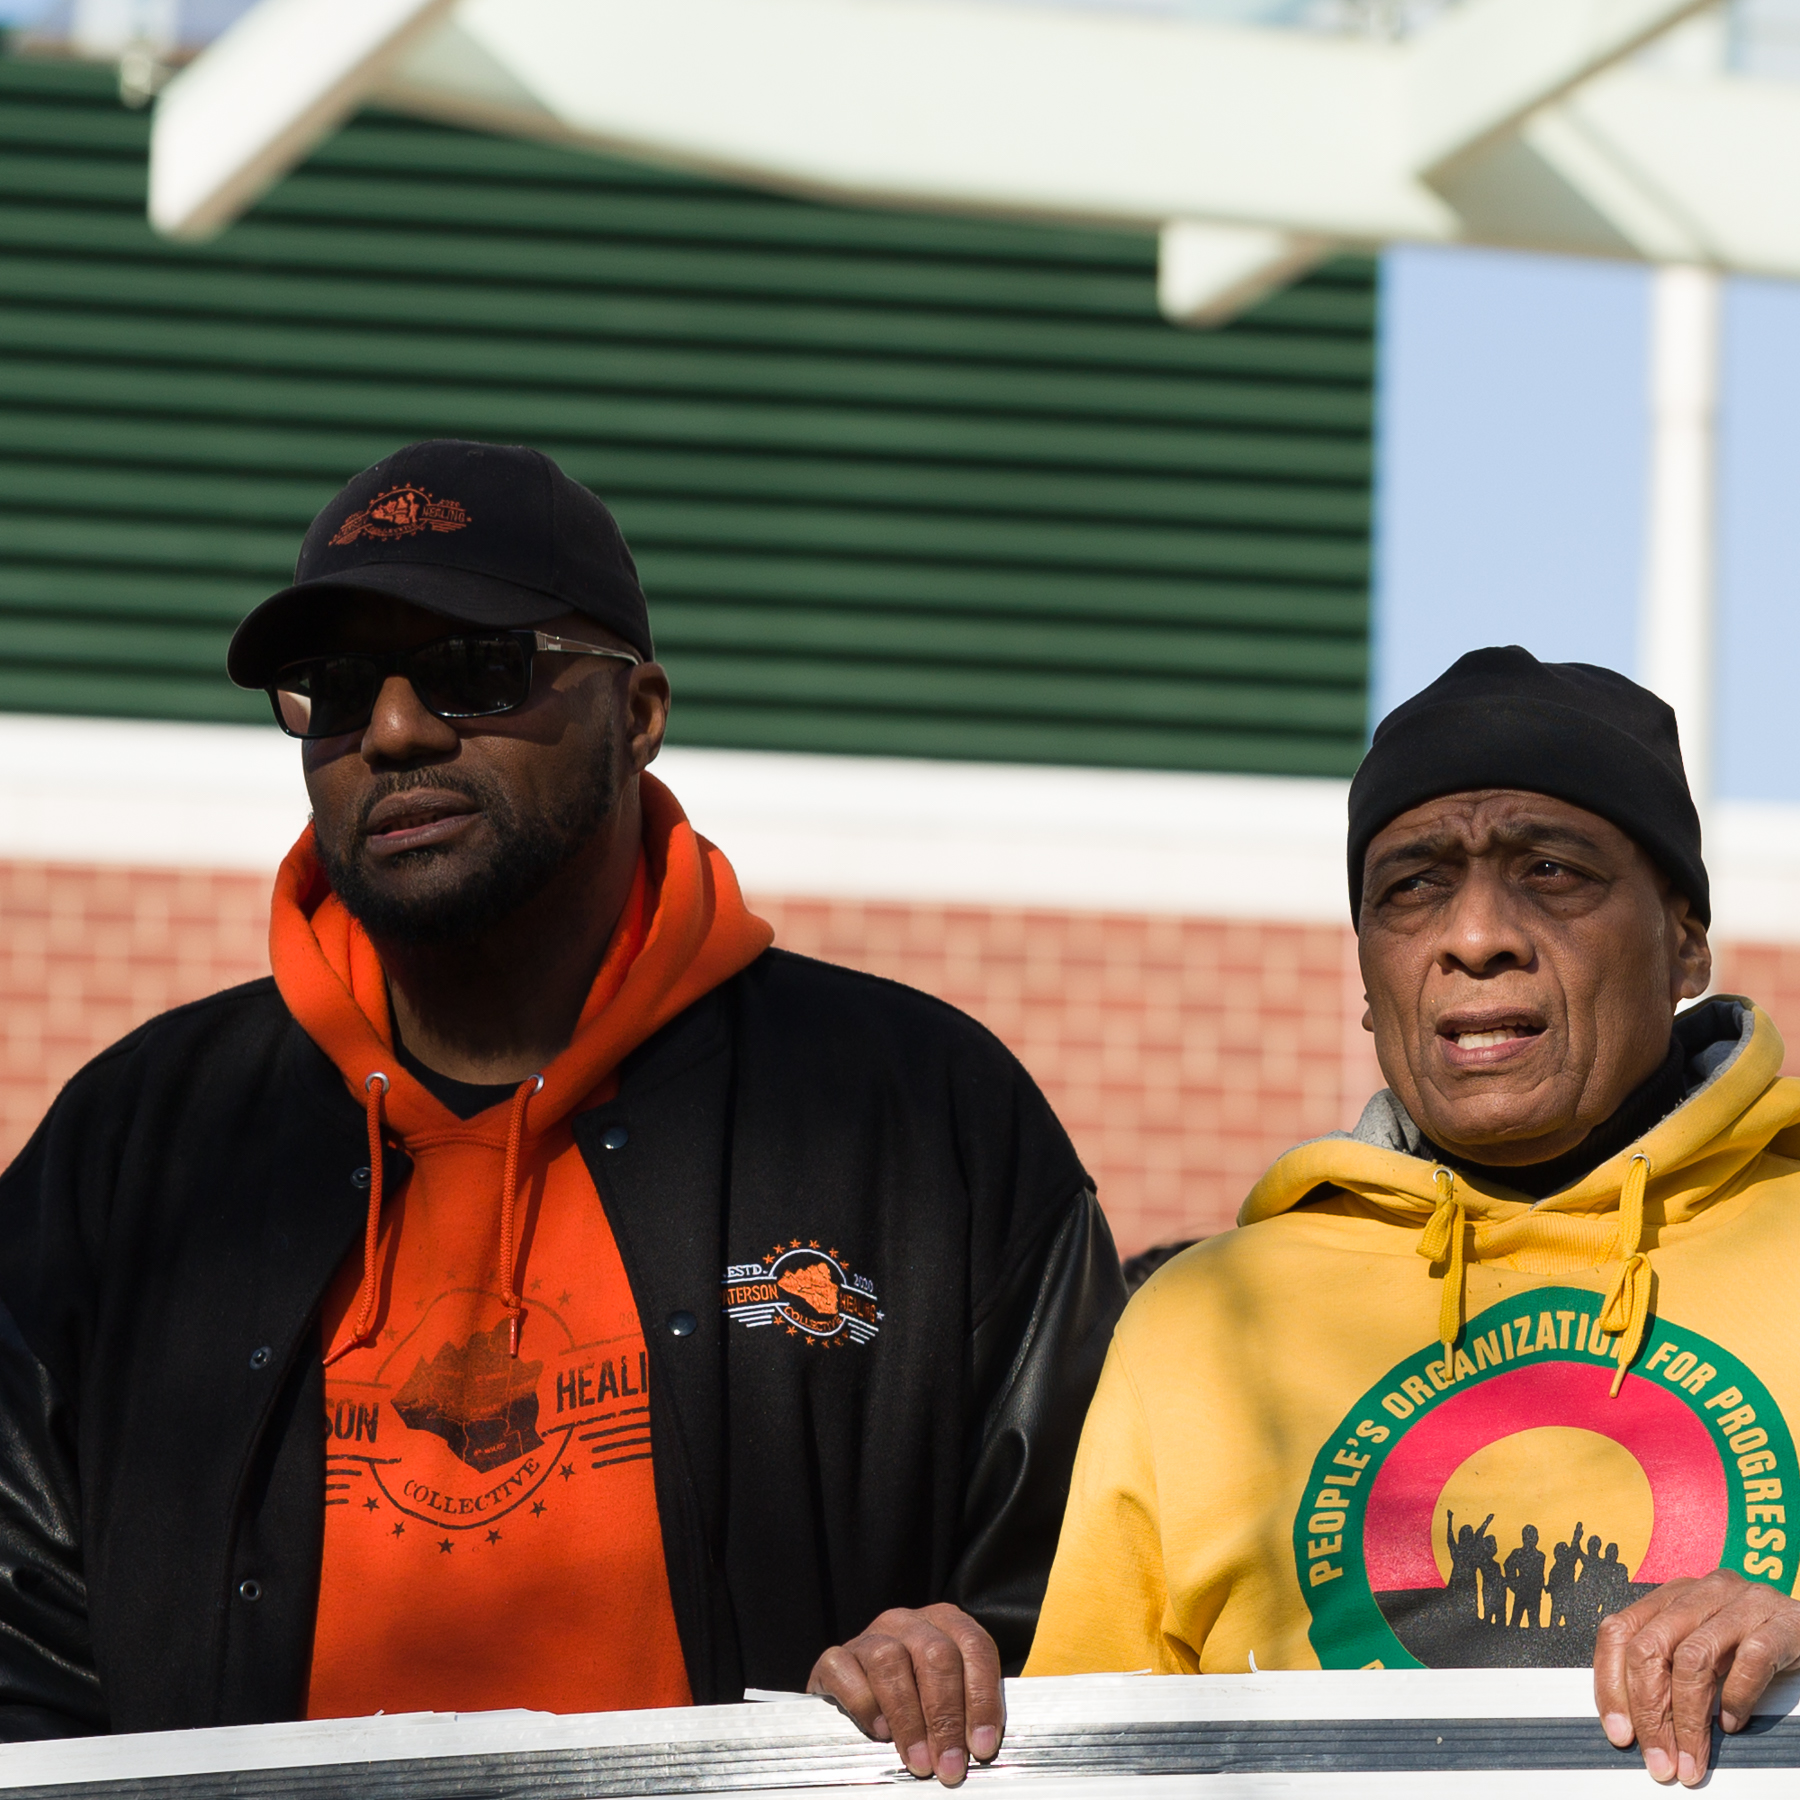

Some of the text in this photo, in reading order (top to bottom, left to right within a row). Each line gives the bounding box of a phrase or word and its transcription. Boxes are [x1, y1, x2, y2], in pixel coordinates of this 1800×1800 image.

[784, 1306, 843, 1331] COLLECTIVE
[403, 1457, 540, 1515] COLLECTIVE
[1309, 1419, 1390, 1587] PEOPLE'S
[1646, 1341, 1718, 1395] FOR
[1705, 1386, 1786, 1581] PROGRESS
